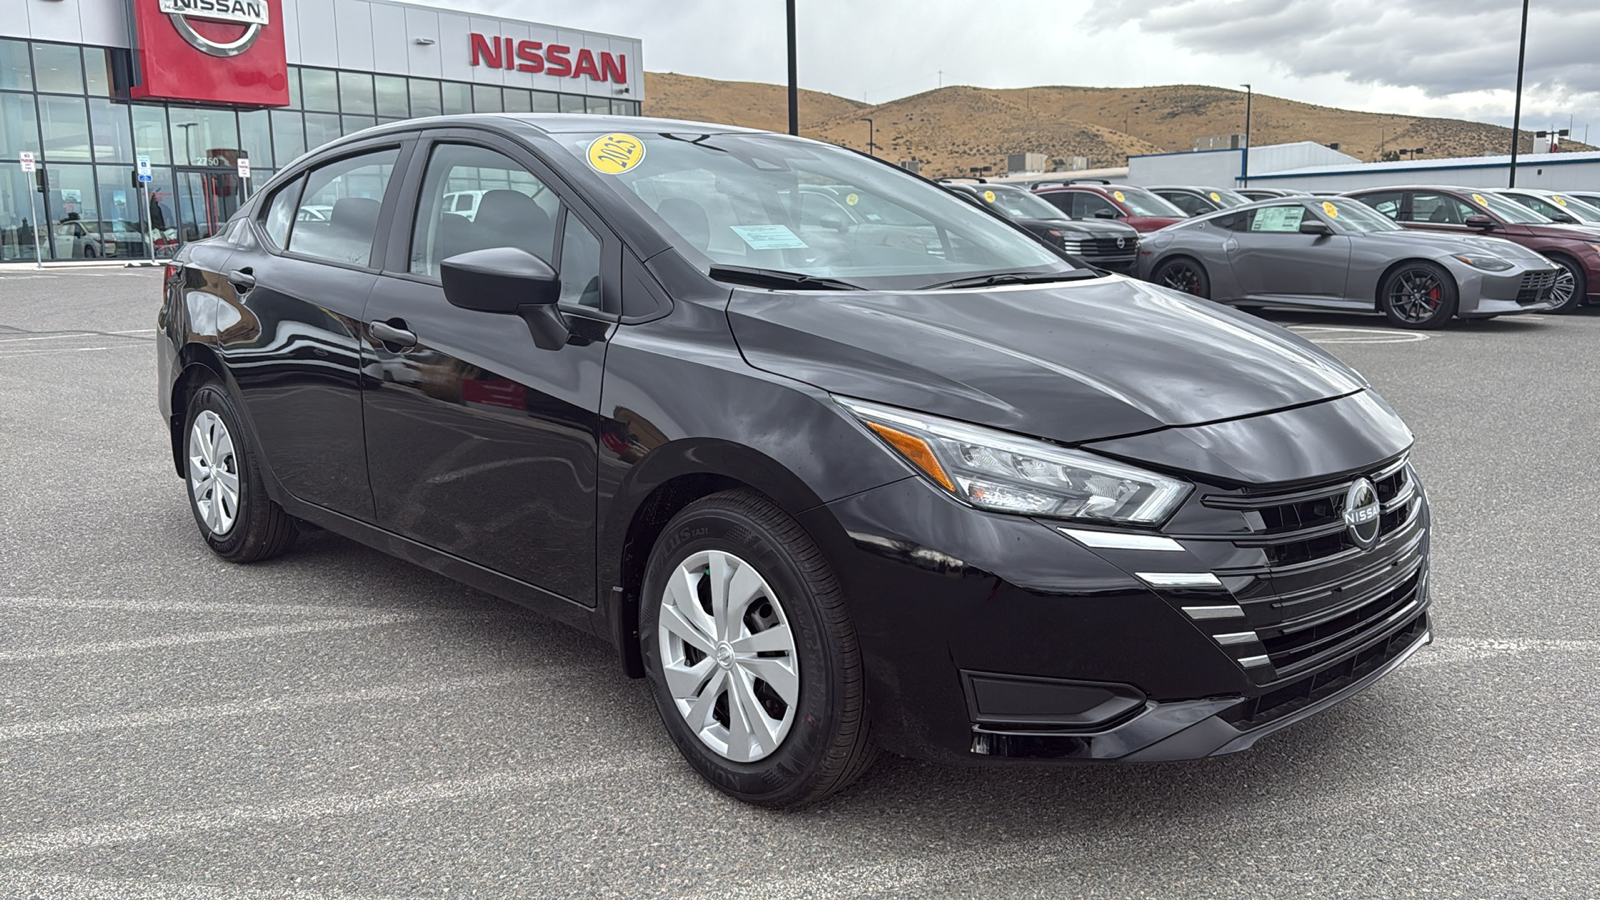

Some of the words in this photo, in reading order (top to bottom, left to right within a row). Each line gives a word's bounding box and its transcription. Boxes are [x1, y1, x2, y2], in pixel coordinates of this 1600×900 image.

[470, 33, 627, 84] NISSAN
[196, 156, 220, 166] 2750
[597, 136, 637, 168] 2025
